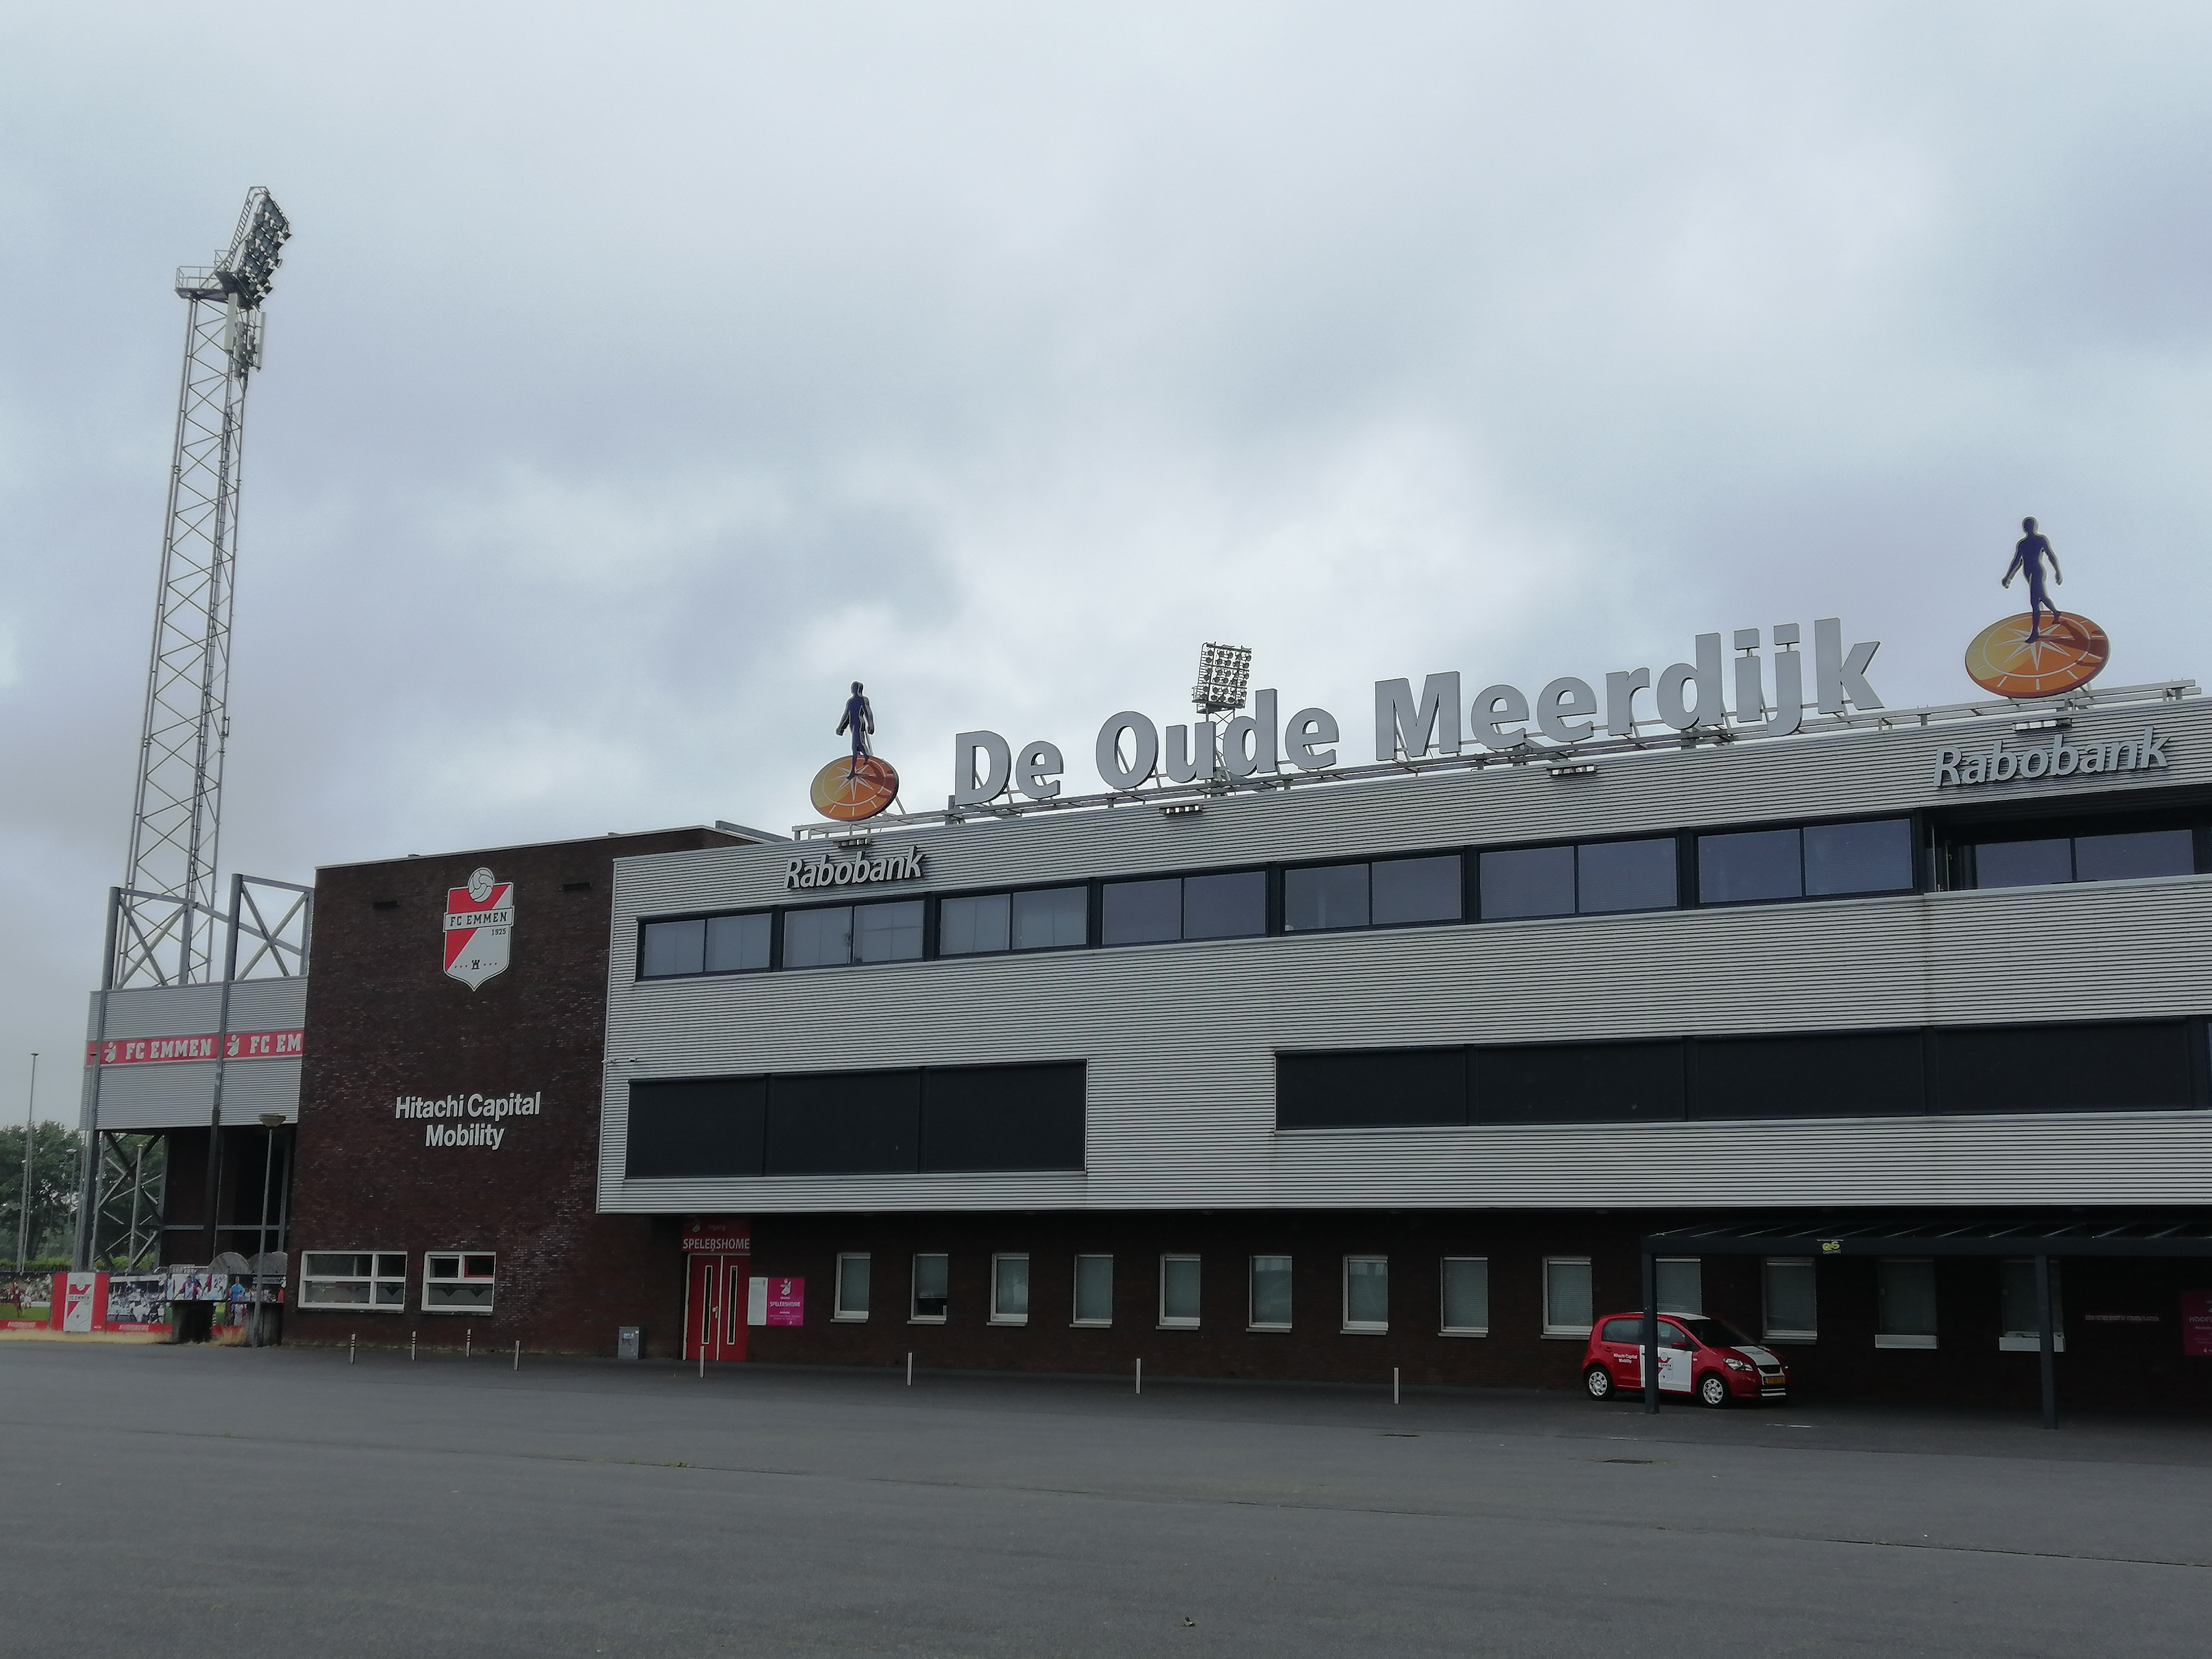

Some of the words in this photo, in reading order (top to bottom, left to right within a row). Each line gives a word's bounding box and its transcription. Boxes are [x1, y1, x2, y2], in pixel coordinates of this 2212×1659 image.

[955, 730, 1064, 806] De
[1096, 688, 1339, 789] Oude
[1374, 617, 1886, 762] Meerdijk
[1933, 725, 2171, 788] Rabobank
[783, 845, 927, 890] Rabobank
[450, 916, 462, 926] FC
[467, 912, 508, 925] EMMEN
[491, 928, 506, 936] 1925
[125, 1042, 145, 1060] FC
[150, 1038, 212, 1058] EMMEN
[250, 1036, 270, 1054] FC
[395, 1094, 464, 1119] Hitachi
[467, 1092, 542, 1122] Capital
[425, 1124, 505, 1150] Mobility
[683, 1238, 750, 1249] SPELERSHOME
